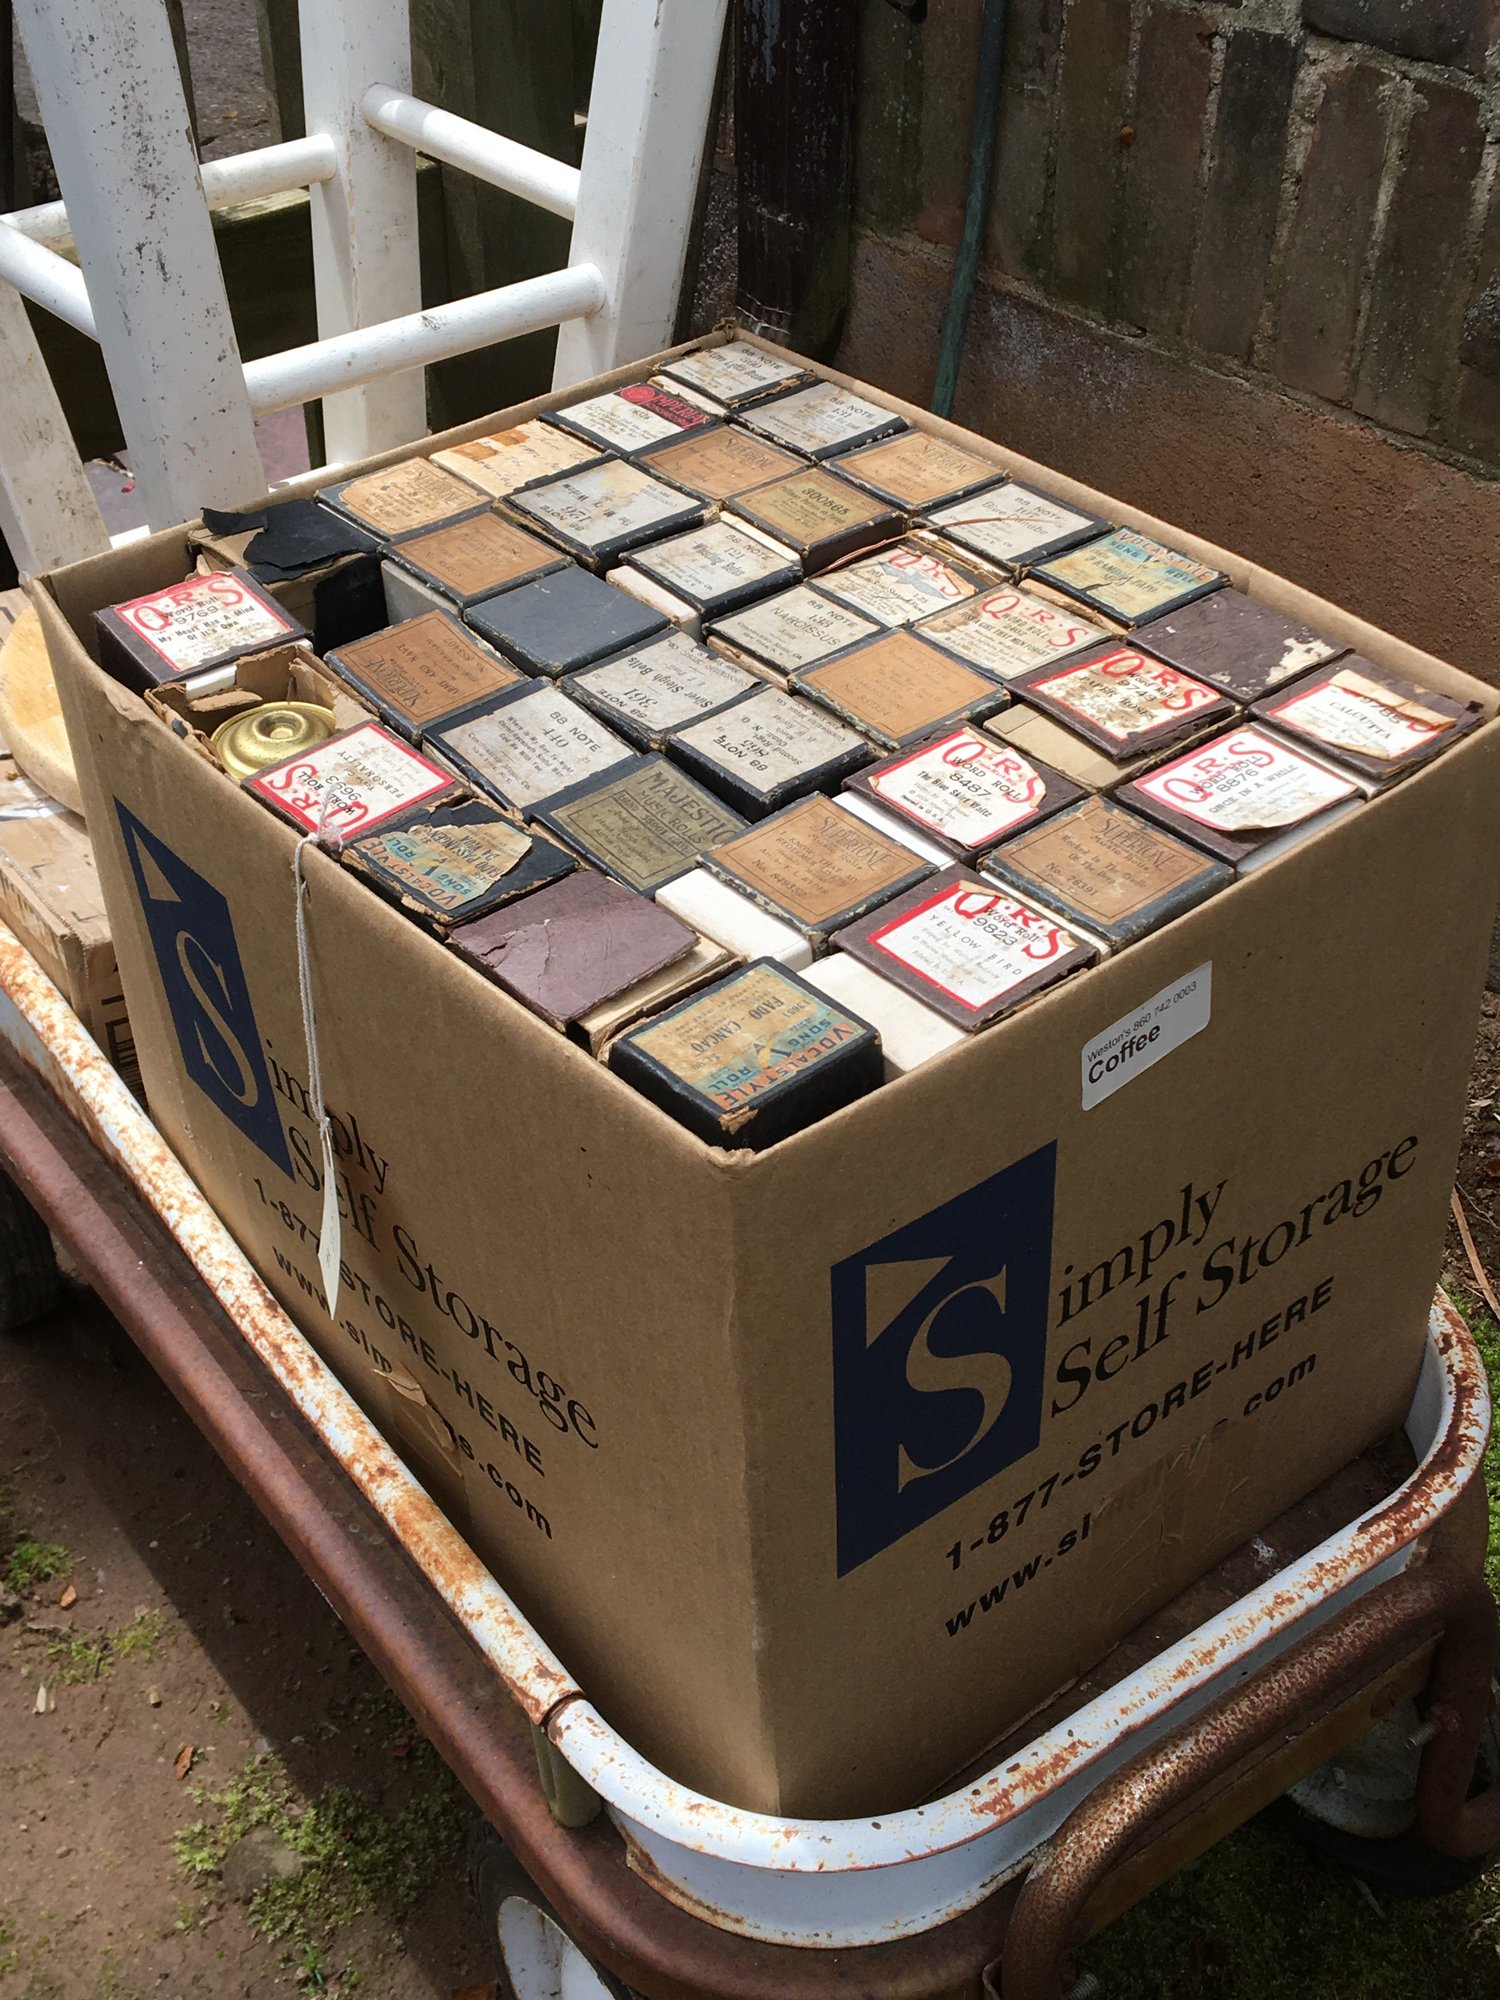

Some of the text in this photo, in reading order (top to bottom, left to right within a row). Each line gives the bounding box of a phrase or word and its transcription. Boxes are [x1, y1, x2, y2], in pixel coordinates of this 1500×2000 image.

[844, 404, 877, 419] NOTE
[555, 482, 592, 501] Widow
[798, 487, 854, 516] 300565
[979, 500, 1011, 515] Blue
[537, 504, 569, 521] NOTE
[559, 505, 594, 522] 126
[722, 547, 747, 560] 121
[723, 534, 772, 561] 88 NOTE
[1108, 540, 1195, 584] SONG ROLL
[1115, 532, 1214, 582] VOCASTYLE
[161, 595, 222, 619] Word Roll
[173, 605, 220, 625] 9769
[803, 600, 859, 628] 88 NOTE
[157, 634, 174, 643] My
[174, 624, 200, 636] Heart
[201, 618, 220, 627] Has
[230, 605, 256, 616] Mind
[199, 627, 218, 636] It's
[219, 619, 241, 629] Own
[765, 606, 843, 646] NARCISSUS
[998, 611, 1052, 638] WORD ROLL
[991, 628, 1013, 639] THAT
[1008, 637, 1028, 647] MEN
[1021, 643, 1051, 658] FORGET
[418, 663, 438, 678] AND
[621, 656, 715, 708] Silver Sleigh Bells
[1123, 671, 1179, 699] Word Roll
[594, 687, 650, 719] 88 NOTE
[619, 685, 661, 709] 361
[1077, 675, 1120, 697] PAPER
[1116, 696, 1162, 720] ROSES
[1113, 679, 1160, 702] 9743
[504, 715, 526, 731] Where
[1324, 699, 1399, 740] CALCUTTA
[1351, 695, 1408, 724] 9785
[497, 732, 512, 743] God
[539, 725, 571, 748] 440
[549, 711, 602, 752] 88 NOTE
[736, 714, 790, 747] Conn. N. G.
[711, 735, 769, 771] 88 NOTE
[736, 737, 771, 758] 865
[747, 731, 805, 765] Second Regt.
[293, 770, 327, 791] ROLL
[321, 774, 364, 801] 9693
[333, 749, 409, 798] PERSONALITY
[946, 771, 993, 800] 8487
[948, 755, 1024, 801] WORD ROLL
[1189, 753, 1266, 795] WORD ROLL
[1205, 763, 1300, 813] ONCE IN A WHILE
[1214, 767, 1262, 792] 8876
[635, 771, 738, 846] MAJESTIC
[915, 770, 994, 818] The Blue Skirt Waltz
[634, 789, 673, 819] MUSIC
[667, 815, 707, 846] ROLLS
[476, 849, 502, 860] DA
[772, 837, 818, 866] REDEEMER
[804, 814, 897, 871] SUPERTONE
[1057, 834, 1093, 856] Rocked
[1089, 854, 1104, 863] In
[1102, 861, 1122, 873] The
[1088, 817, 1183, 871] SUPERTONE
[1088, 834, 1152, 871] Music Rolls
[379, 836, 474, 895] SONG ROLL
[748, 858, 771, 872] No.
[785, 836, 860, 883] KNOW THAT MY
[1066, 852, 1119, 886] Of The Deep
[1042, 861, 1099, 897] No. 76391
[967, 915, 1021, 947] 9823
[979, 907, 1042, 942] Word Roll
[925, 913, 986, 950] YELLOW
[984, 952, 1027, 977] BIRD
[744, 994, 788, 1020] FADO
[1087, 981, 1197, 1062] Weston's 860 742 0003
[785, 1018, 835, 1047] SONG
[714, 1023, 855, 1106] VOCALSTYLE
[1088, 1025, 1160, 1084] Coffee
[707, 1065, 754, 1093] ROLL
[1056, 1179, 1228, 1328] imply
[1051, 1136, 1418, 1418] Self Storage
[254, 1177, 545, 1477] 1-877STORE-HERE
[392, 1225, 598, 1449] Storage
[945, 1276, 1334, 1570] 1-877-STORE-HERE
